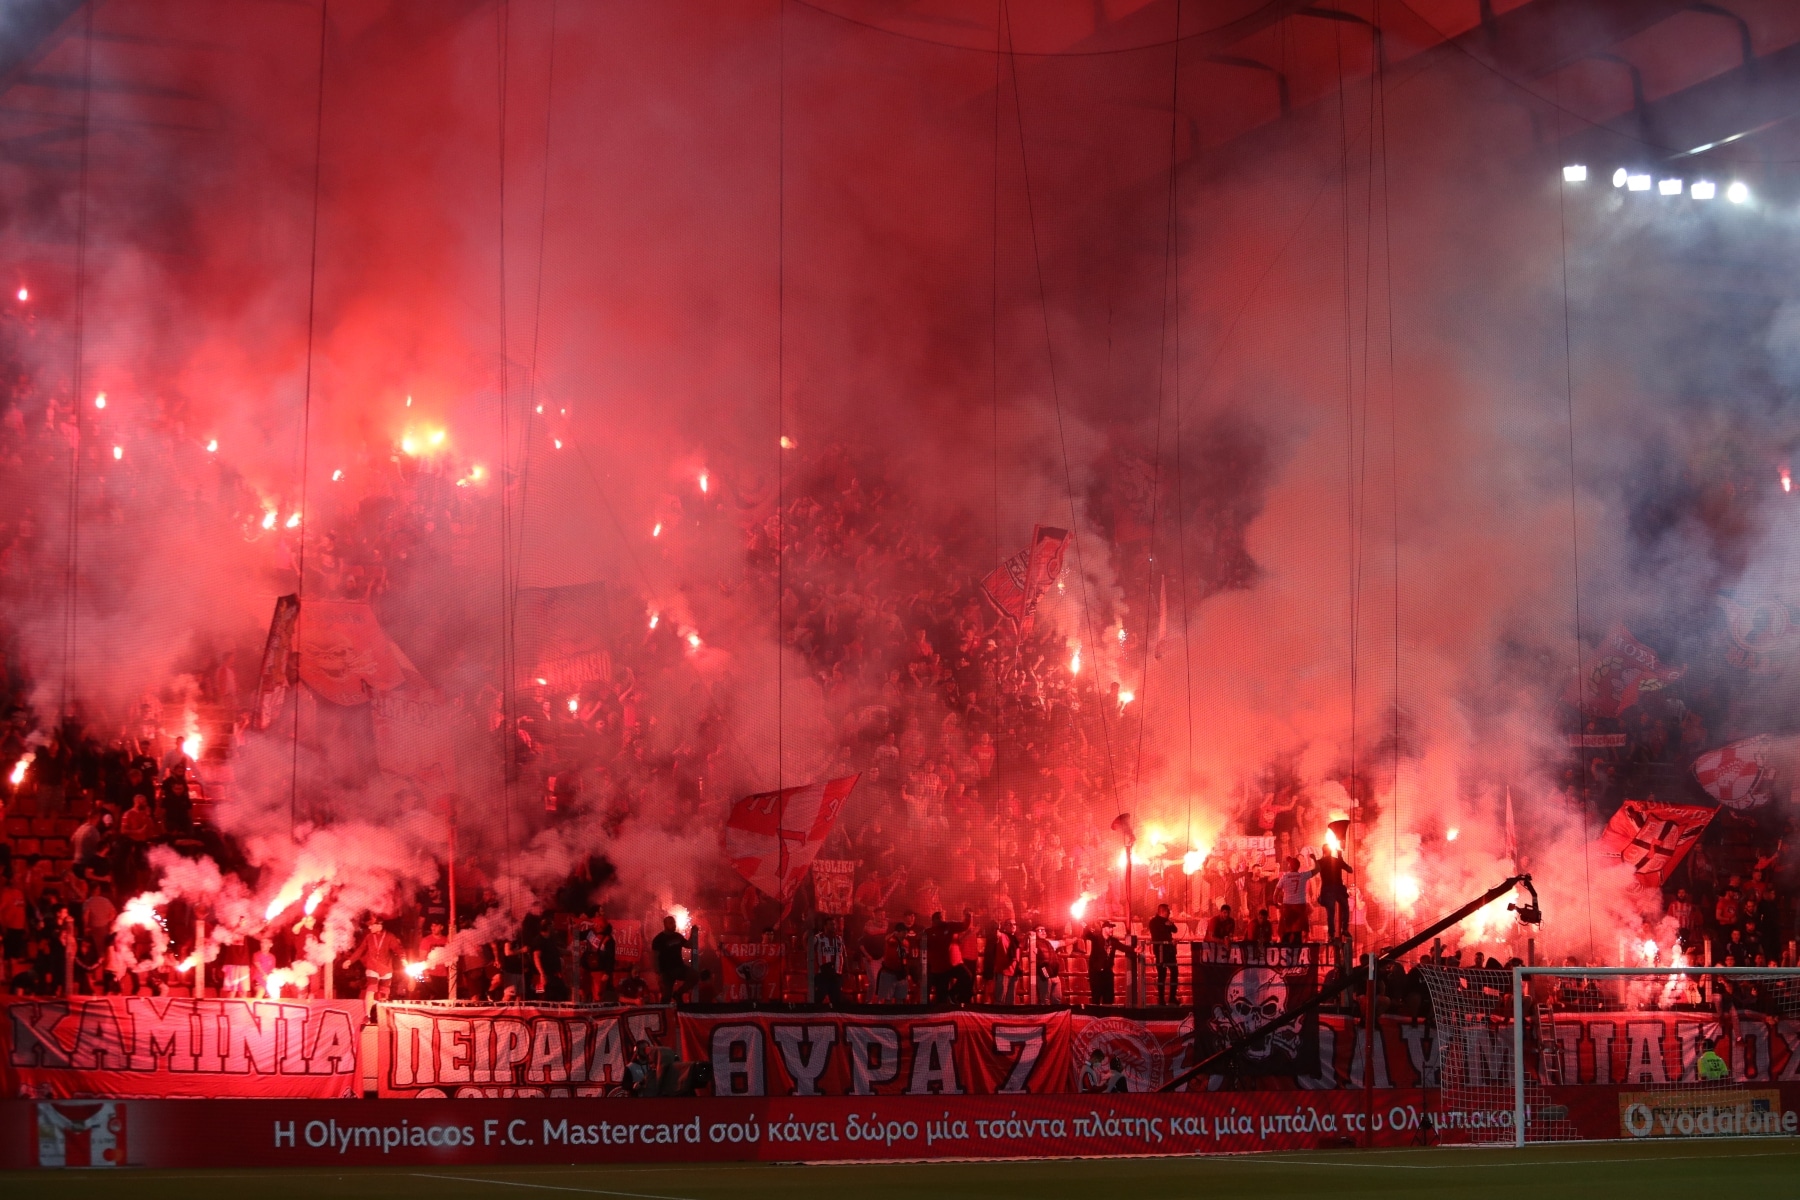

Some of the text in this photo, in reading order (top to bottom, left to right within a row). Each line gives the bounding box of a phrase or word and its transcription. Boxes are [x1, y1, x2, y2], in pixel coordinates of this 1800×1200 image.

[1612, 633, 1680, 681] ΜΟΣΧΟ
[721, 943, 786, 957] KARDITSA
[1201, 942, 1243, 964] NEA
[8, 998, 358, 1074] ΚΑΜΙΝΙΑ
[711, 1022, 964, 1097] ΘΥΡΑ
[994, 1024, 1046, 1096] 7
[304, 1118, 475, 1154] Olympiacos
[484, 1118, 534, 1146] F.C.
[543, 1115, 701, 1145] Mastercard
[709, 1113, 760, 1143] σού
[768, 1112, 840, 1142] κάνει
[846, 1112, 919, 1147] δώρο
[926, 1111, 968, 1145] μία
[975, 1110, 1067, 1139] τσάντα
[1072, 1110, 1163, 1143] πλάτης
[1170, 1116, 1207, 1137] και
[1215, 1107, 1255, 1141] μία
[1260, 1105, 1336, 1140] μπάλα
[1343, 1113, 1383, 1132] του
[1389, 1104, 1532, 1136] Ολυμπιακο!
[1658, 1104, 1799, 1135] vodafone
